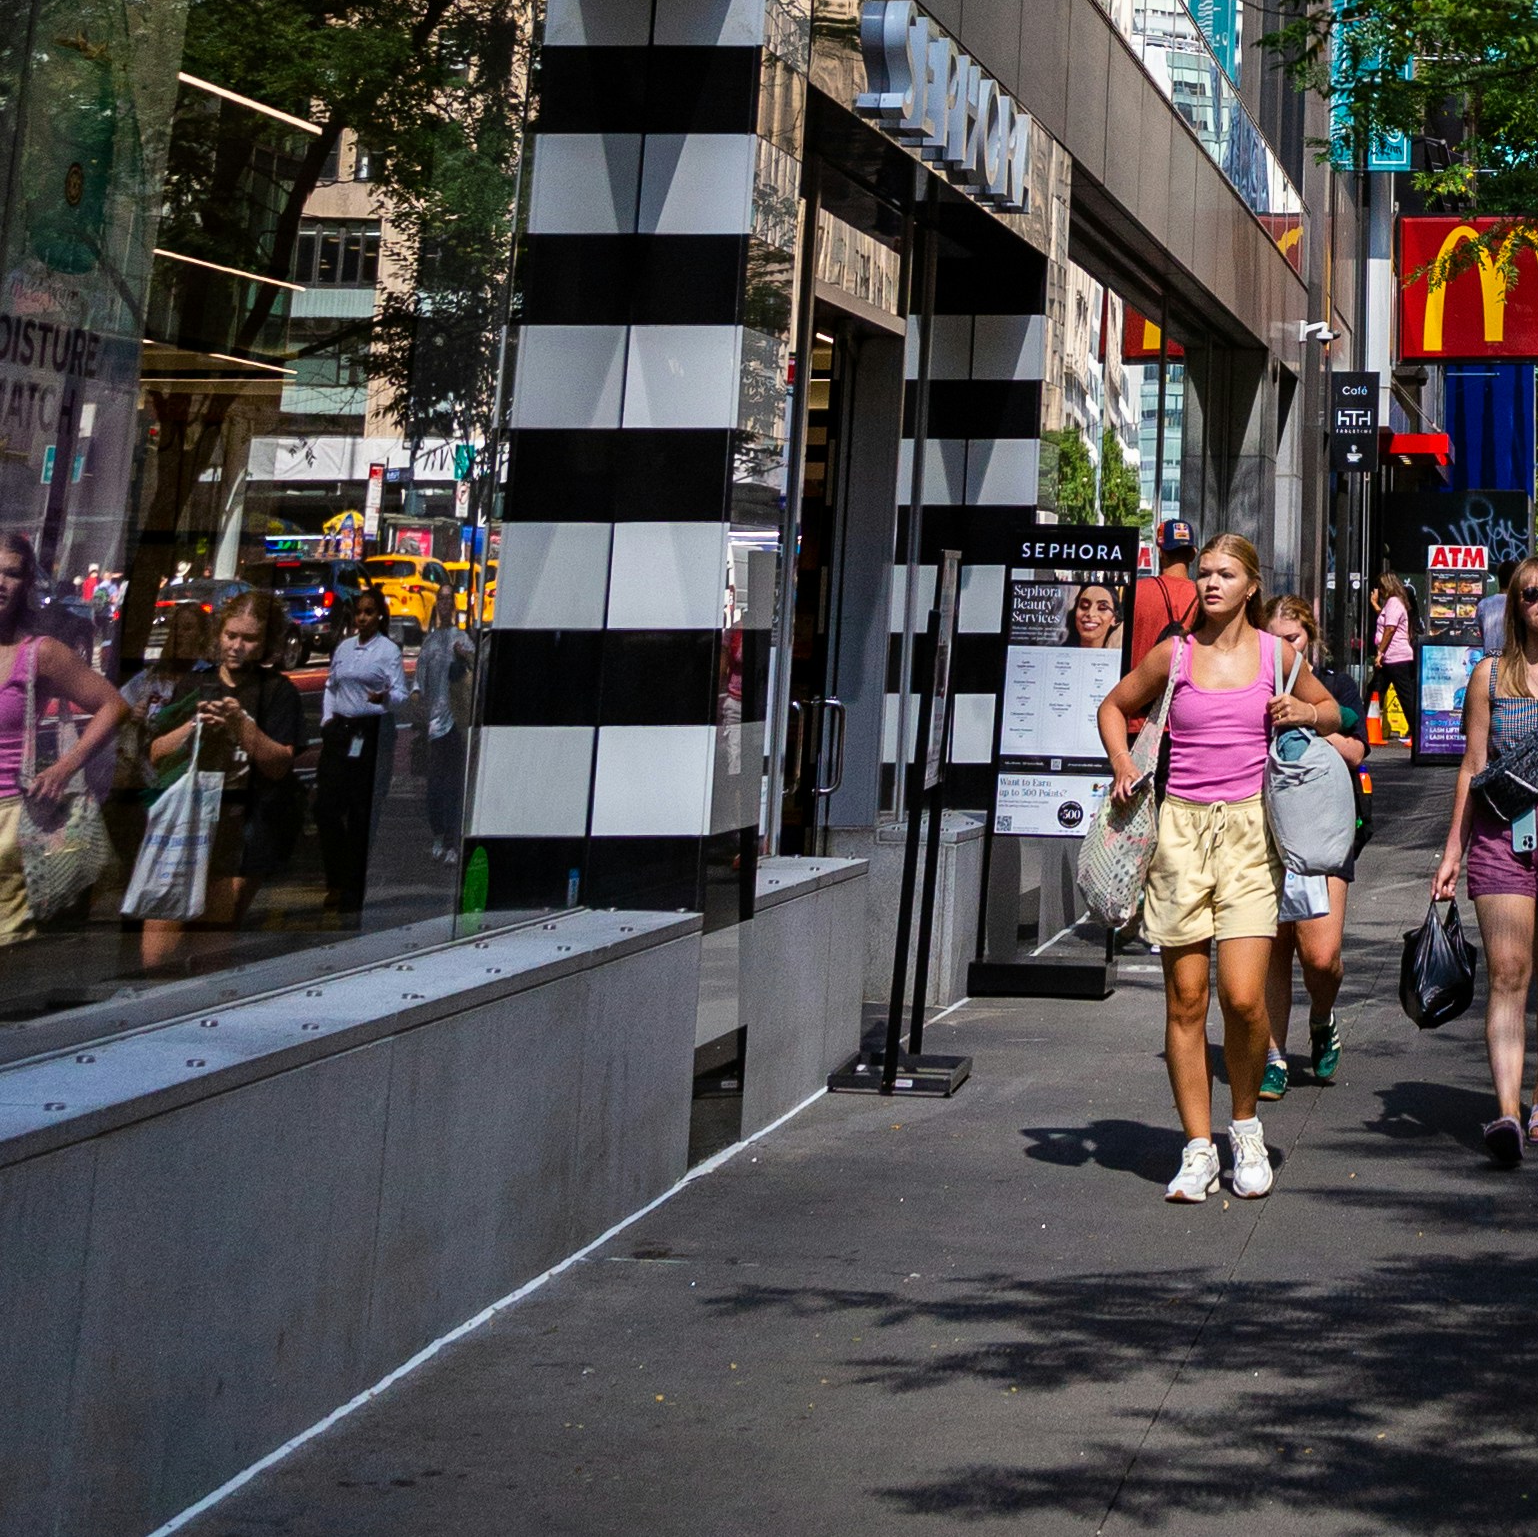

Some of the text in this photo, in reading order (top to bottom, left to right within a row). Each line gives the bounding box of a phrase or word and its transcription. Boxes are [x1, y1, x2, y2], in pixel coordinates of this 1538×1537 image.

[1342, 386, 1368, 395] Café
[1021, 542, 1123, 561] SEPHORA
[1430, 546, 1486, 569] ATM
[1013, 585, 1062, 600] Sephora
[1012, 597, 1055, 613] Beauty
[1011, 611, 1061, 624] Services
[1000, 778, 1052, 788] Want to Earn
[999, 790, 1010, 799] up
[1011, 789, 1020, 798] to
